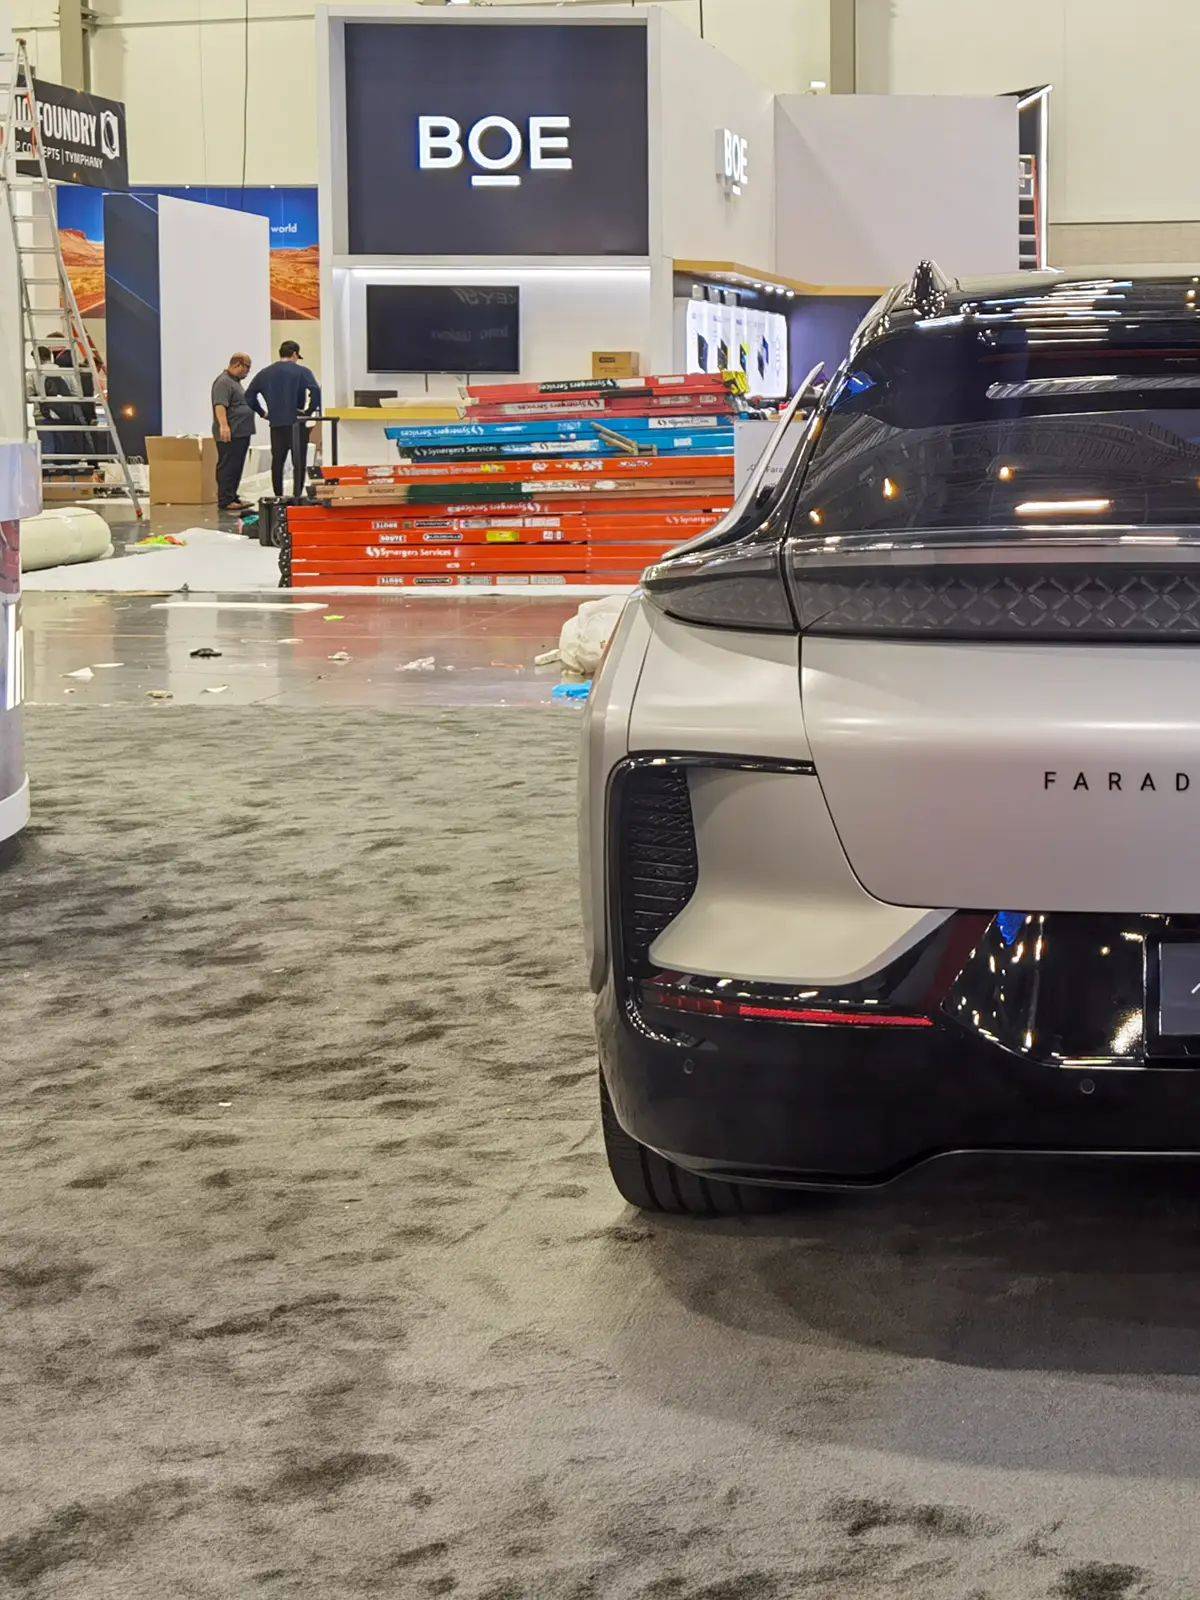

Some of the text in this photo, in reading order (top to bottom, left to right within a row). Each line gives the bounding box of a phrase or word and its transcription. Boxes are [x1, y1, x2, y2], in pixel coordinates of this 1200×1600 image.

[36, 100, 97, 147] FOUNDRY
[418, 115, 573, 170] BOE
[64, 151, 104, 169] TYMPHANY
[722, 128, 749, 185] BOE
[270, 223, 298, 234] world
